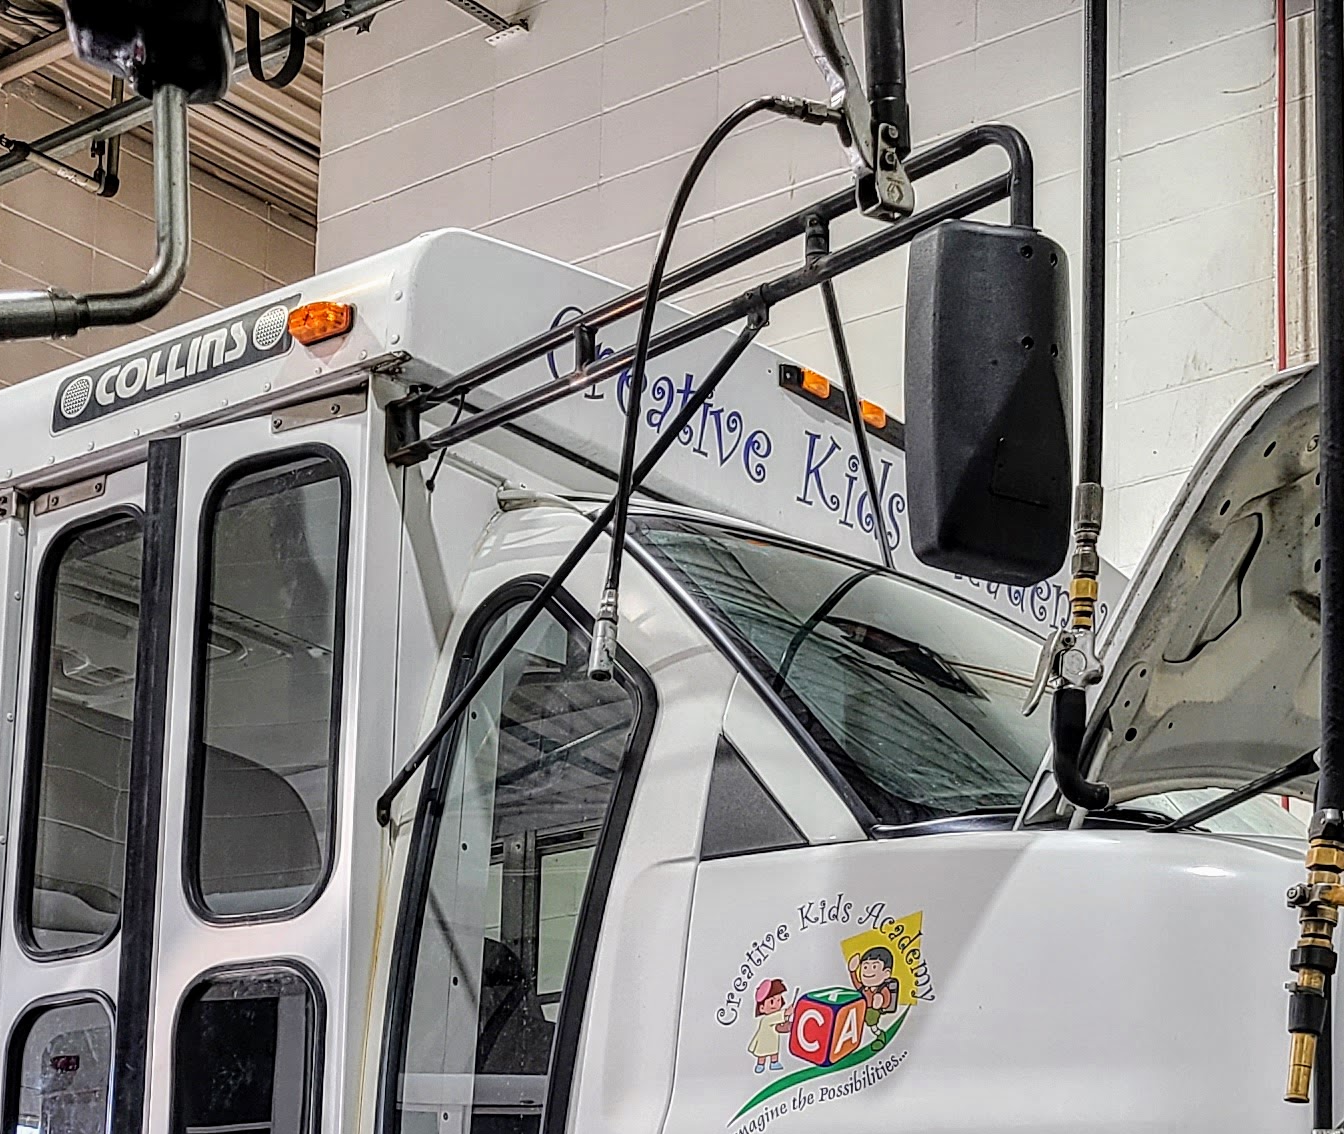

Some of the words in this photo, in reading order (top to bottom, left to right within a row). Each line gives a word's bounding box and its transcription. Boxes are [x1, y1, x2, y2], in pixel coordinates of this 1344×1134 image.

[95, 320, 248, 406] COLLINS
[716, 923, 790, 1027] Creative
[797, 893, 853, 931] Kids
[857, 902, 936, 1003] Academy
[792, 1087, 815, 1112] the
